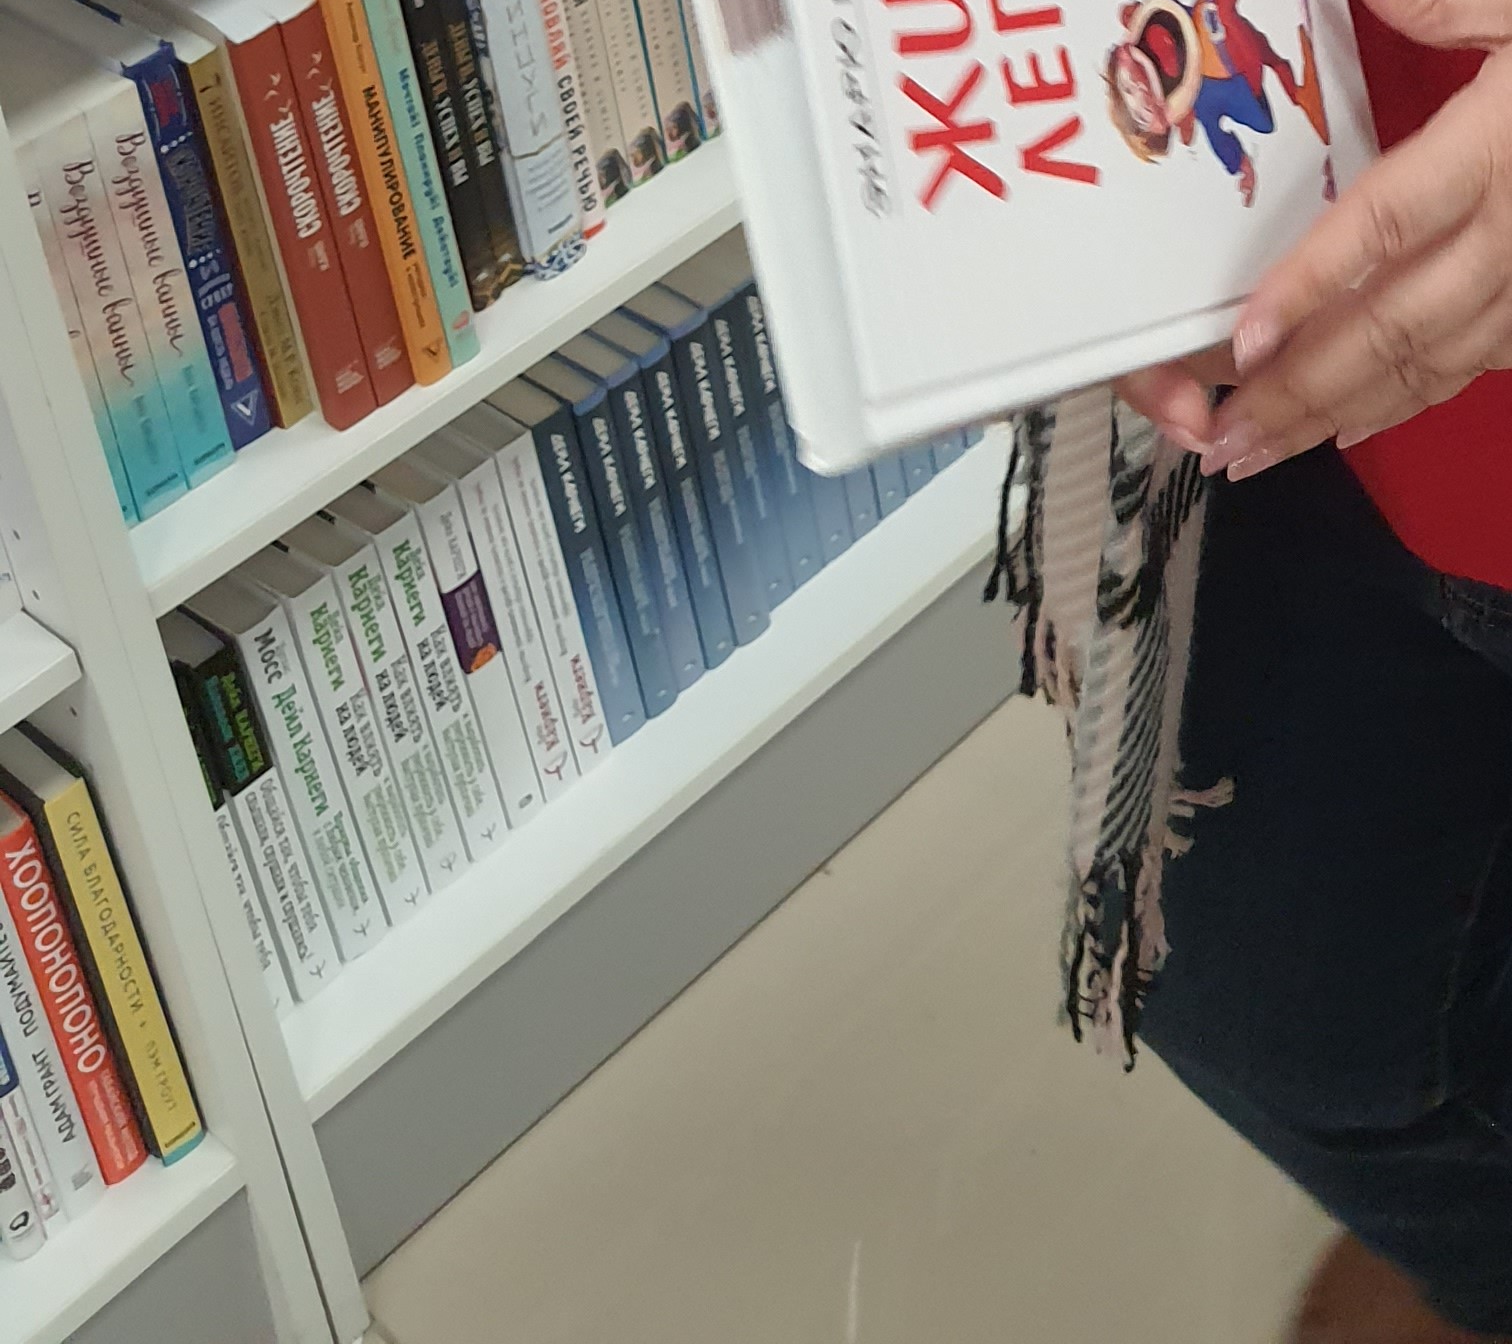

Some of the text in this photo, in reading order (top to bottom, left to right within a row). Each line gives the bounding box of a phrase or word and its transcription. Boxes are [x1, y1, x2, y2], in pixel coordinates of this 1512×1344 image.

[268, 109, 323, 240] СКОРОЧТЕНИЕ
[312, 87, 362, 217] СКОРОЧТЕНИЕ
[362, 85, 417, 261] МАНИПУЛИРОВАНИЕ
[558, 74, 583, 139] СВОЕЙ
[571, 144, 598, 213] РЕЧЬЮ
[4, 838, 105, 1075] ХООПОНОПОНО
[65, 811, 146, 1018] СИЛА БЛАГОДАРНОСТИ
